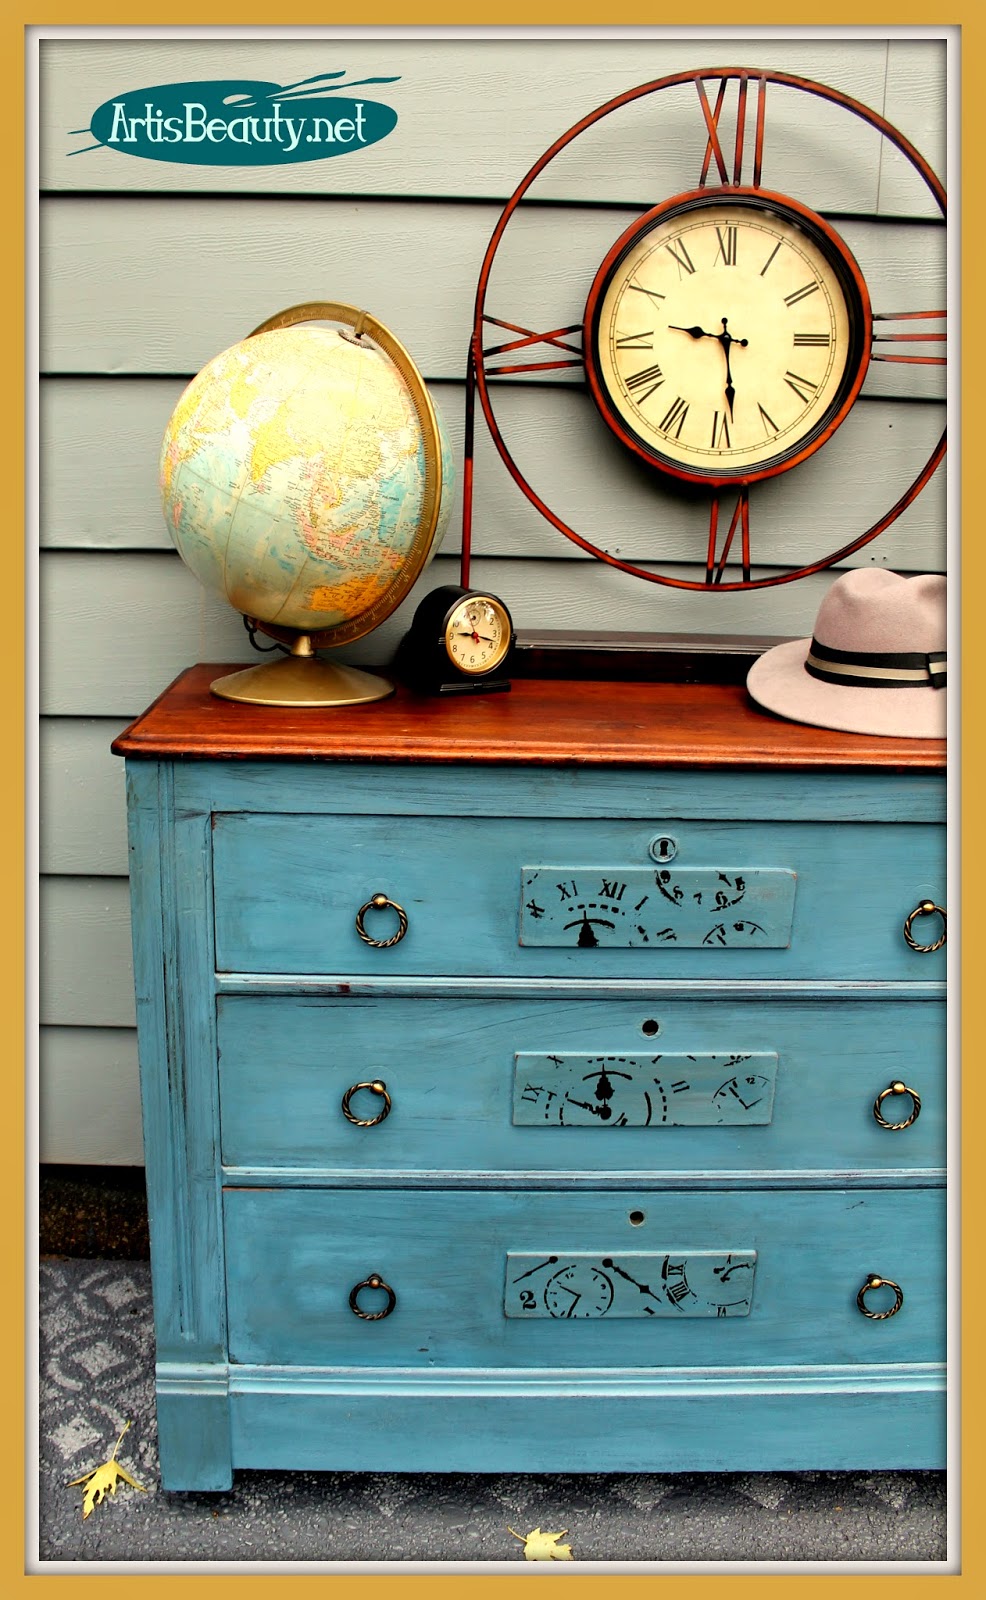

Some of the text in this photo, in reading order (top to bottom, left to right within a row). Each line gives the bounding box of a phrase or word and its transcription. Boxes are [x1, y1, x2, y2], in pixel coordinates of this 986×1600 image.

[713, 226, 740, 267] XII
[664, 237, 698, 282] XI
[783, 280, 820, 308] II
[615, 330, 655, 350] IX
[793, 333, 831, 347] III
[624, 364, 667, 406] VIII
[783, 370, 820, 405] IV
[658, 395, 691, 440] VII
[757, 401, 781, 438] V
[710, 410, 732, 449] VI
[489, 617, 495, 626] 2
[449, 632, 455, 641] 9
[492, 630, 497, 638] 3
[452, 644, 458, 653] 8
[481, 651, 486, 660] 5
[488, 642, 493, 650] 4
[460, 653, 466, 662] 7
[469, 655, 475, 664] 6
[555, 880, 579, 902] XI
[598, 878, 627, 901] XII
[526, 899, 546, 918] X
[521, 1082, 545, 1103] IX
[519, 1290, 538, 1310] 2
